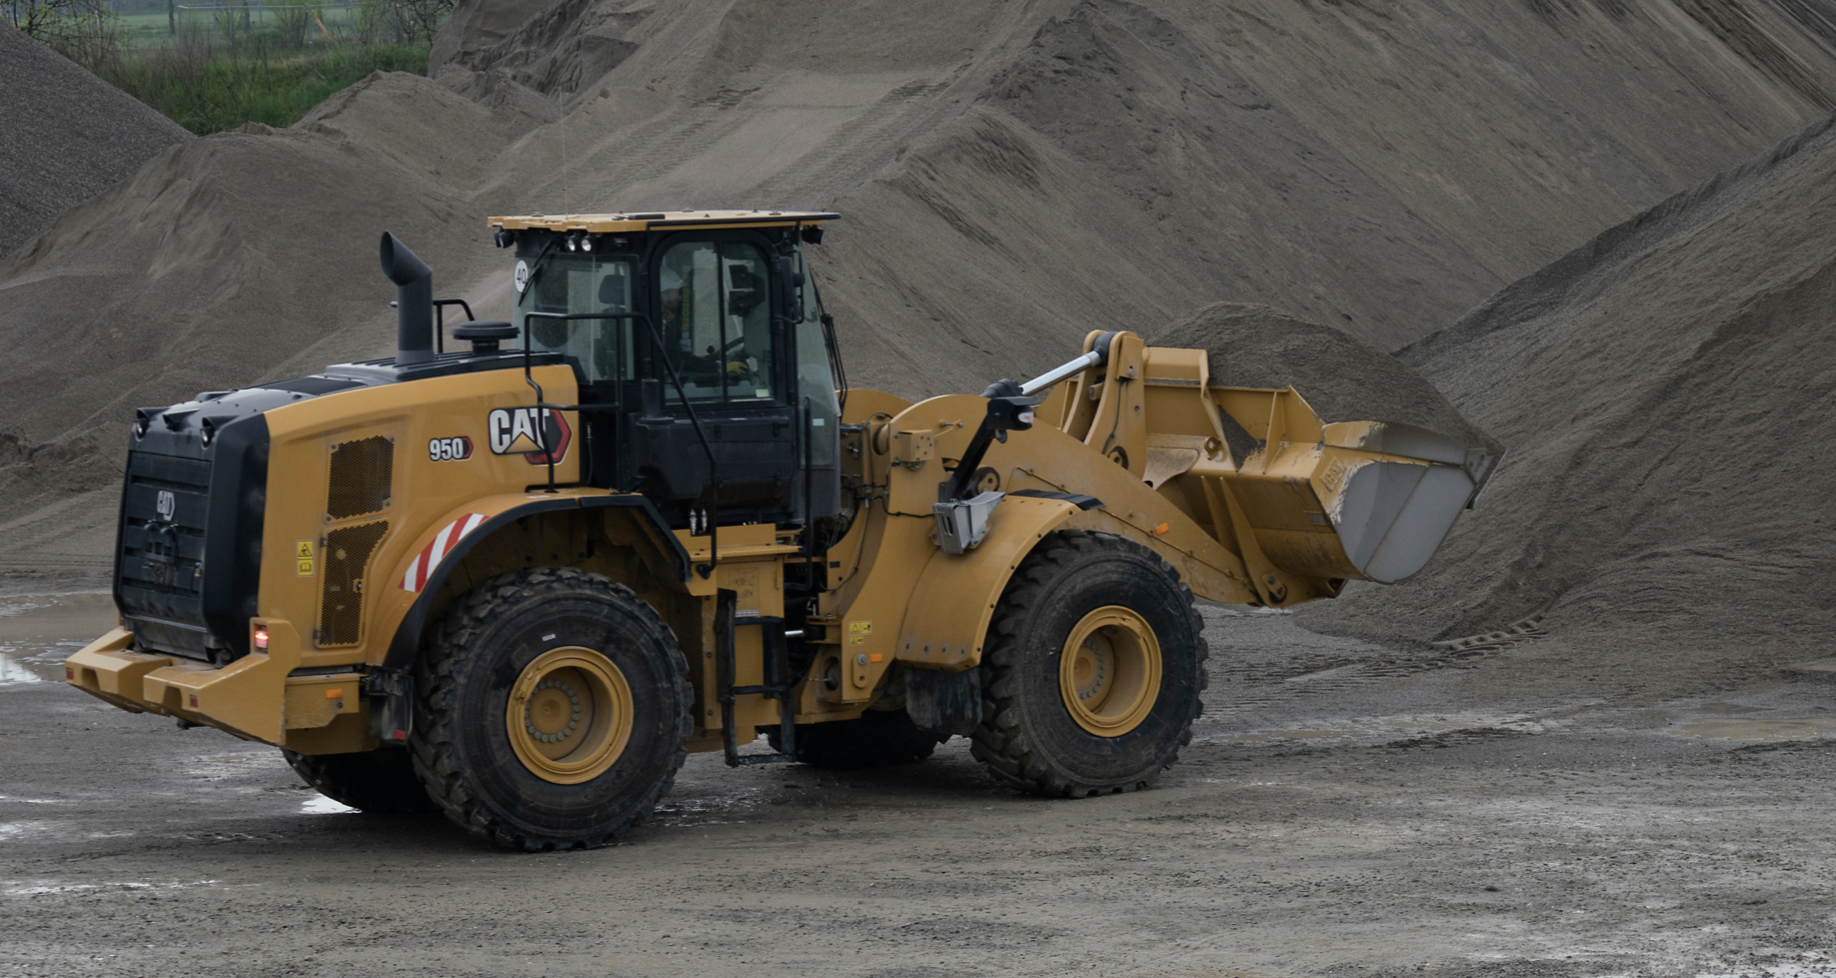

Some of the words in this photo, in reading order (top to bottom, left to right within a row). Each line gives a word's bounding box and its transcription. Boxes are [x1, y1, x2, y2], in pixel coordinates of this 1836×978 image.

[517, 268, 527, 284] 40
[489, 407, 550, 454] CAT
[429, 437, 464, 460] 950
